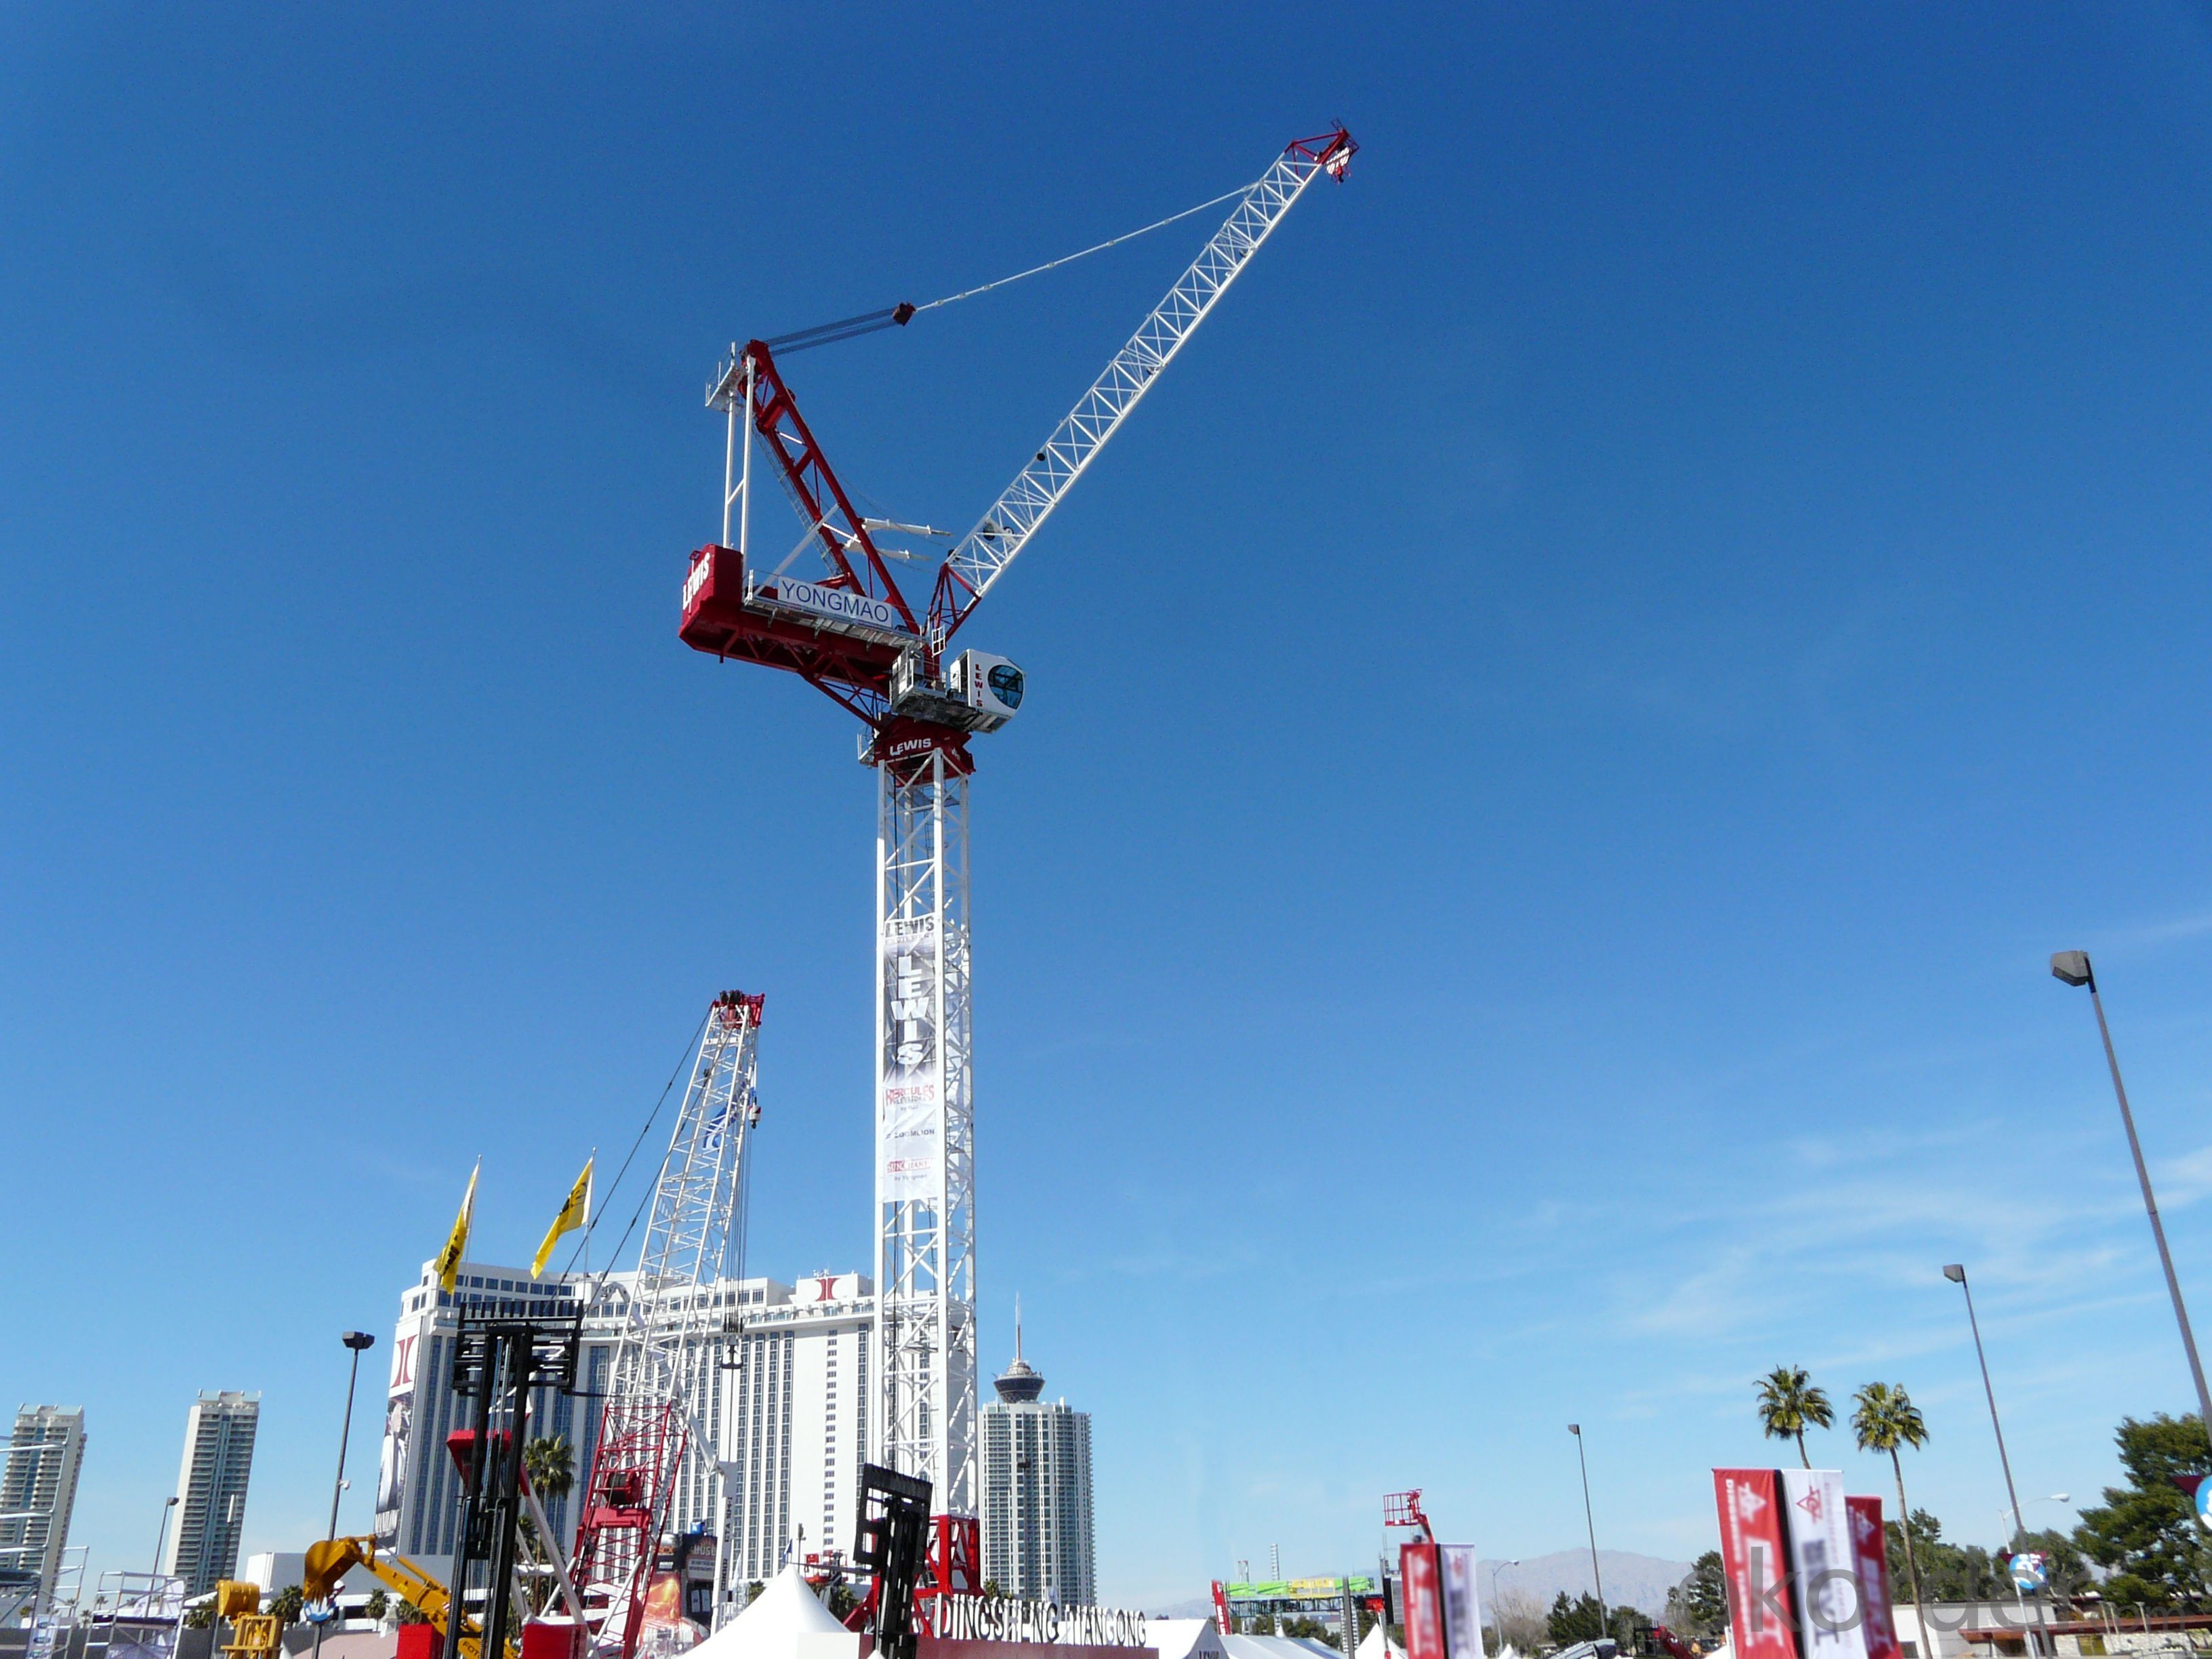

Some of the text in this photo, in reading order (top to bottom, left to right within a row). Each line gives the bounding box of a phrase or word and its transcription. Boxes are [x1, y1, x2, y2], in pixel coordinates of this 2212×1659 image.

[682, 552, 710, 611] LEWIS
[781, 580, 889, 623] YONGMAO
[975, 664, 983, 707] LEWIS
[890, 738, 932, 756] LEWIS
[885, 916, 935, 938] LEWIS
[890, 955, 929, 1065] LEWIS
[885, 1084, 935, 1106] HERCULES
[935, 1593, 1146, 1647] DINGSHENG TIANGONG
